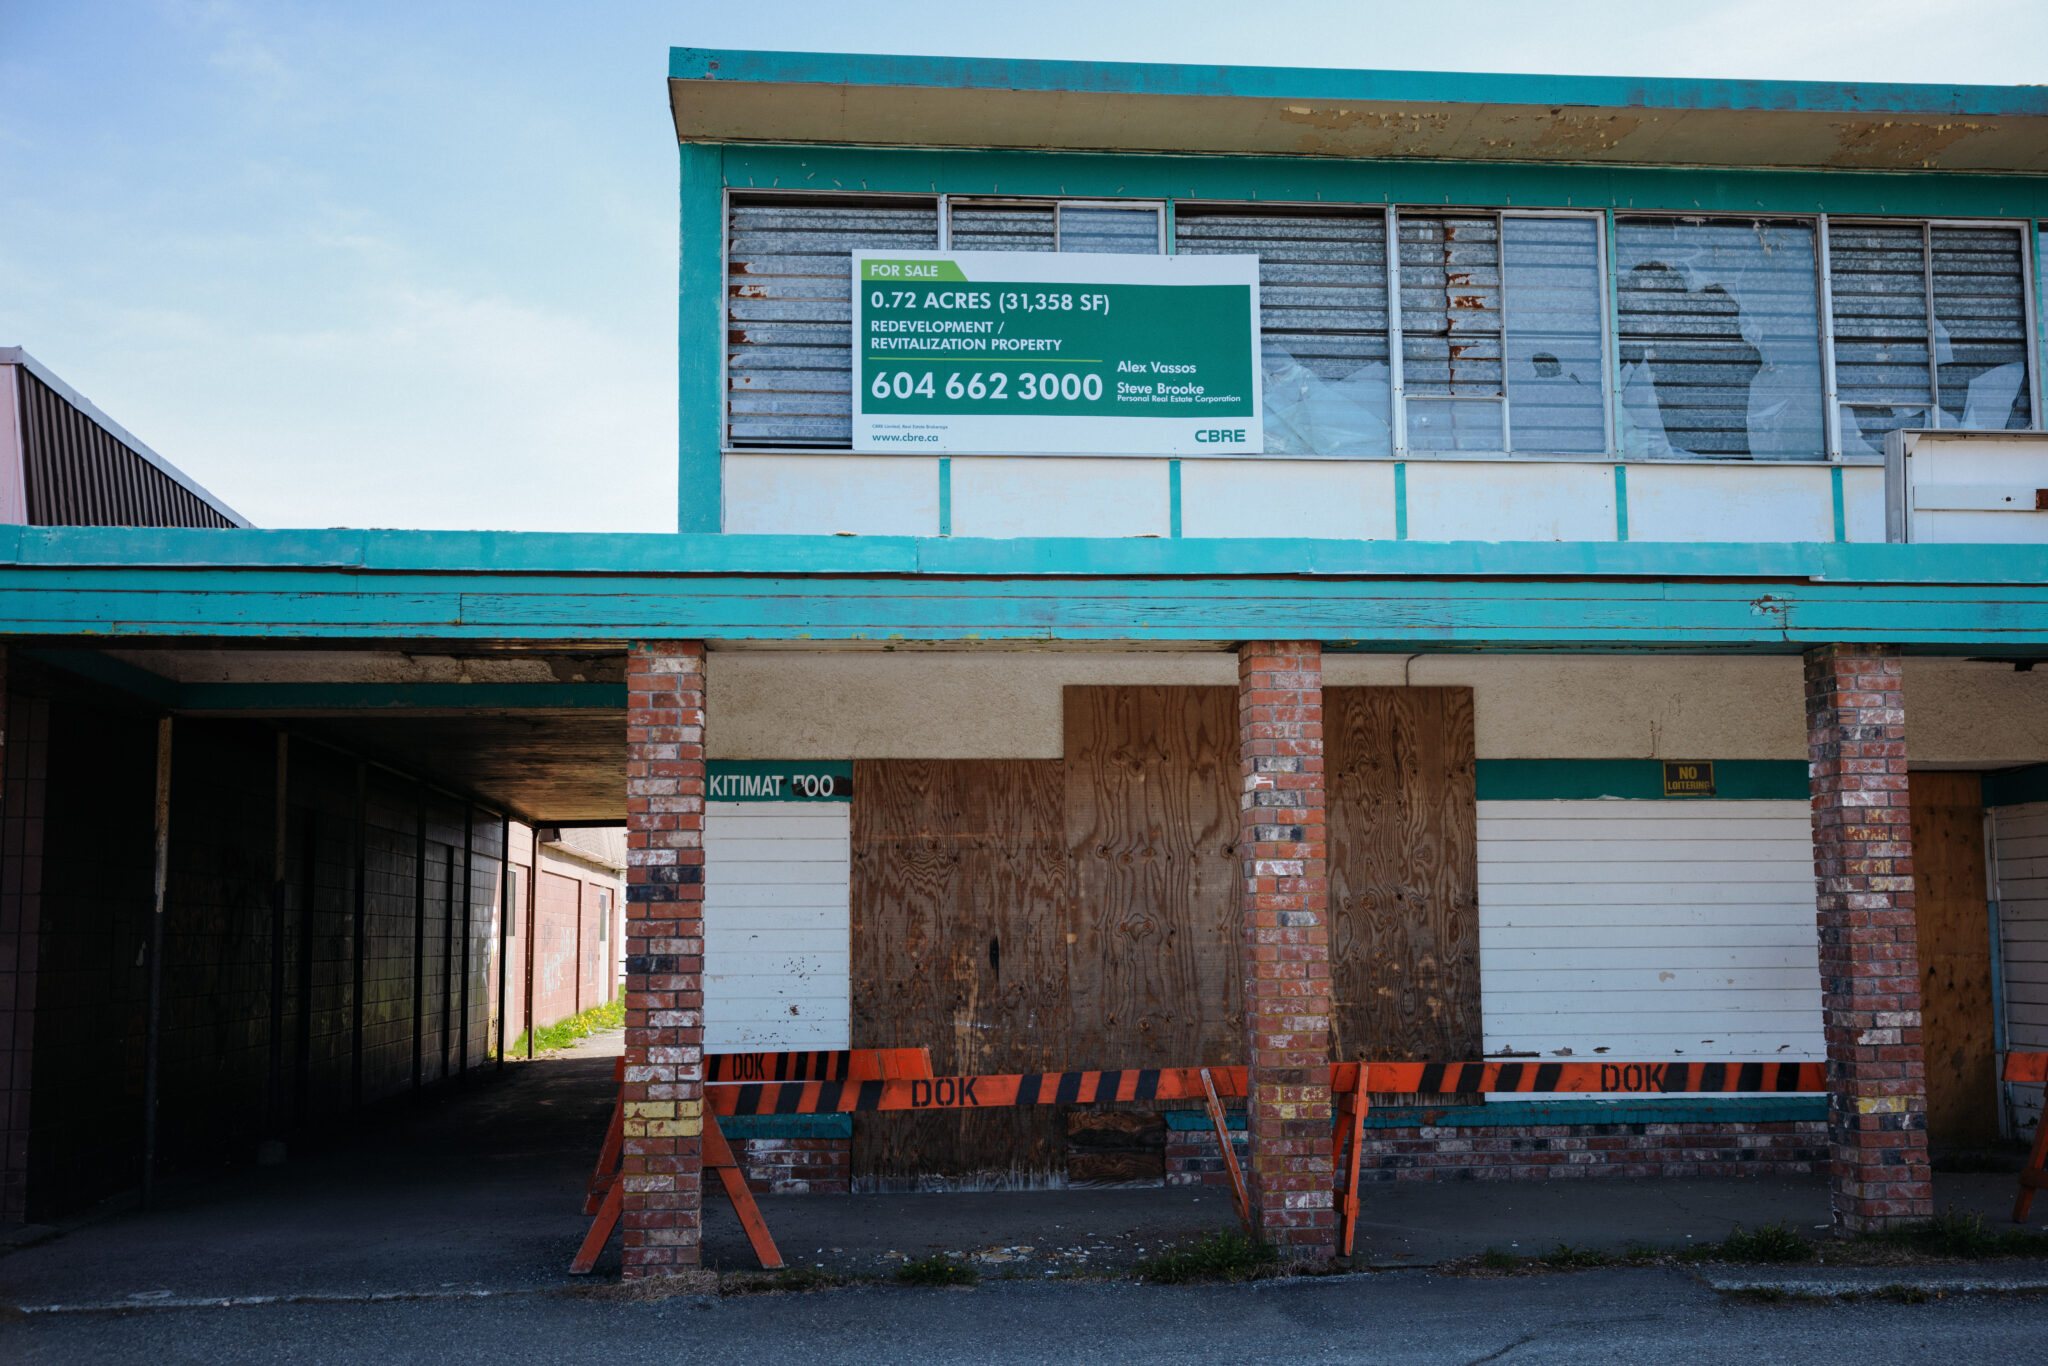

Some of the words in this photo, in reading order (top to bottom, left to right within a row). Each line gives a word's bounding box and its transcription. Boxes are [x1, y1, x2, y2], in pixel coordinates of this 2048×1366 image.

[870, 264, 900, 277] FOR
[904, 264, 939, 277] SALE
[870, 291, 917, 308] 0.72
[923, 291, 992, 309] ACRES
[999, 292, 1074, 314] (31,358
[1080, 293, 1110, 315] SF)
[871, 320, 994, 333] REDEVELOPMENT
[871, 337, 986, 350] REVITALIZATION
[991, 338, 1063, 351] PROPERTY
[1117, 360, 1147, 373] Alex
[1150, 361, 1197, 374] Vassos
[871, 371, 936, 399] 604
[945, 372, 1008, 399] 662
[1017, 372, 1103, 401] 3000
[1117, 381, 1153, 394] Steve
[1157, 382, 1205, 395] Brooke
[1170, 395, 1193, 403] Estate
[1194, 395, 1241, 404] Corporation
[872, 432, 939, 442] www.cbre.ca
[1194, 429, 1246, 443] CBRE
[1679, 766, 1698, 780] NO
[709, 774, 785, 797] KITIMAT
[1667, 781, 1710, 790] LOITERING
[733, 1052, 766, 1081] DOK
[1601, 1063, 1667, 1093] DOK
[911, 1077, 979, 1108] DOK
